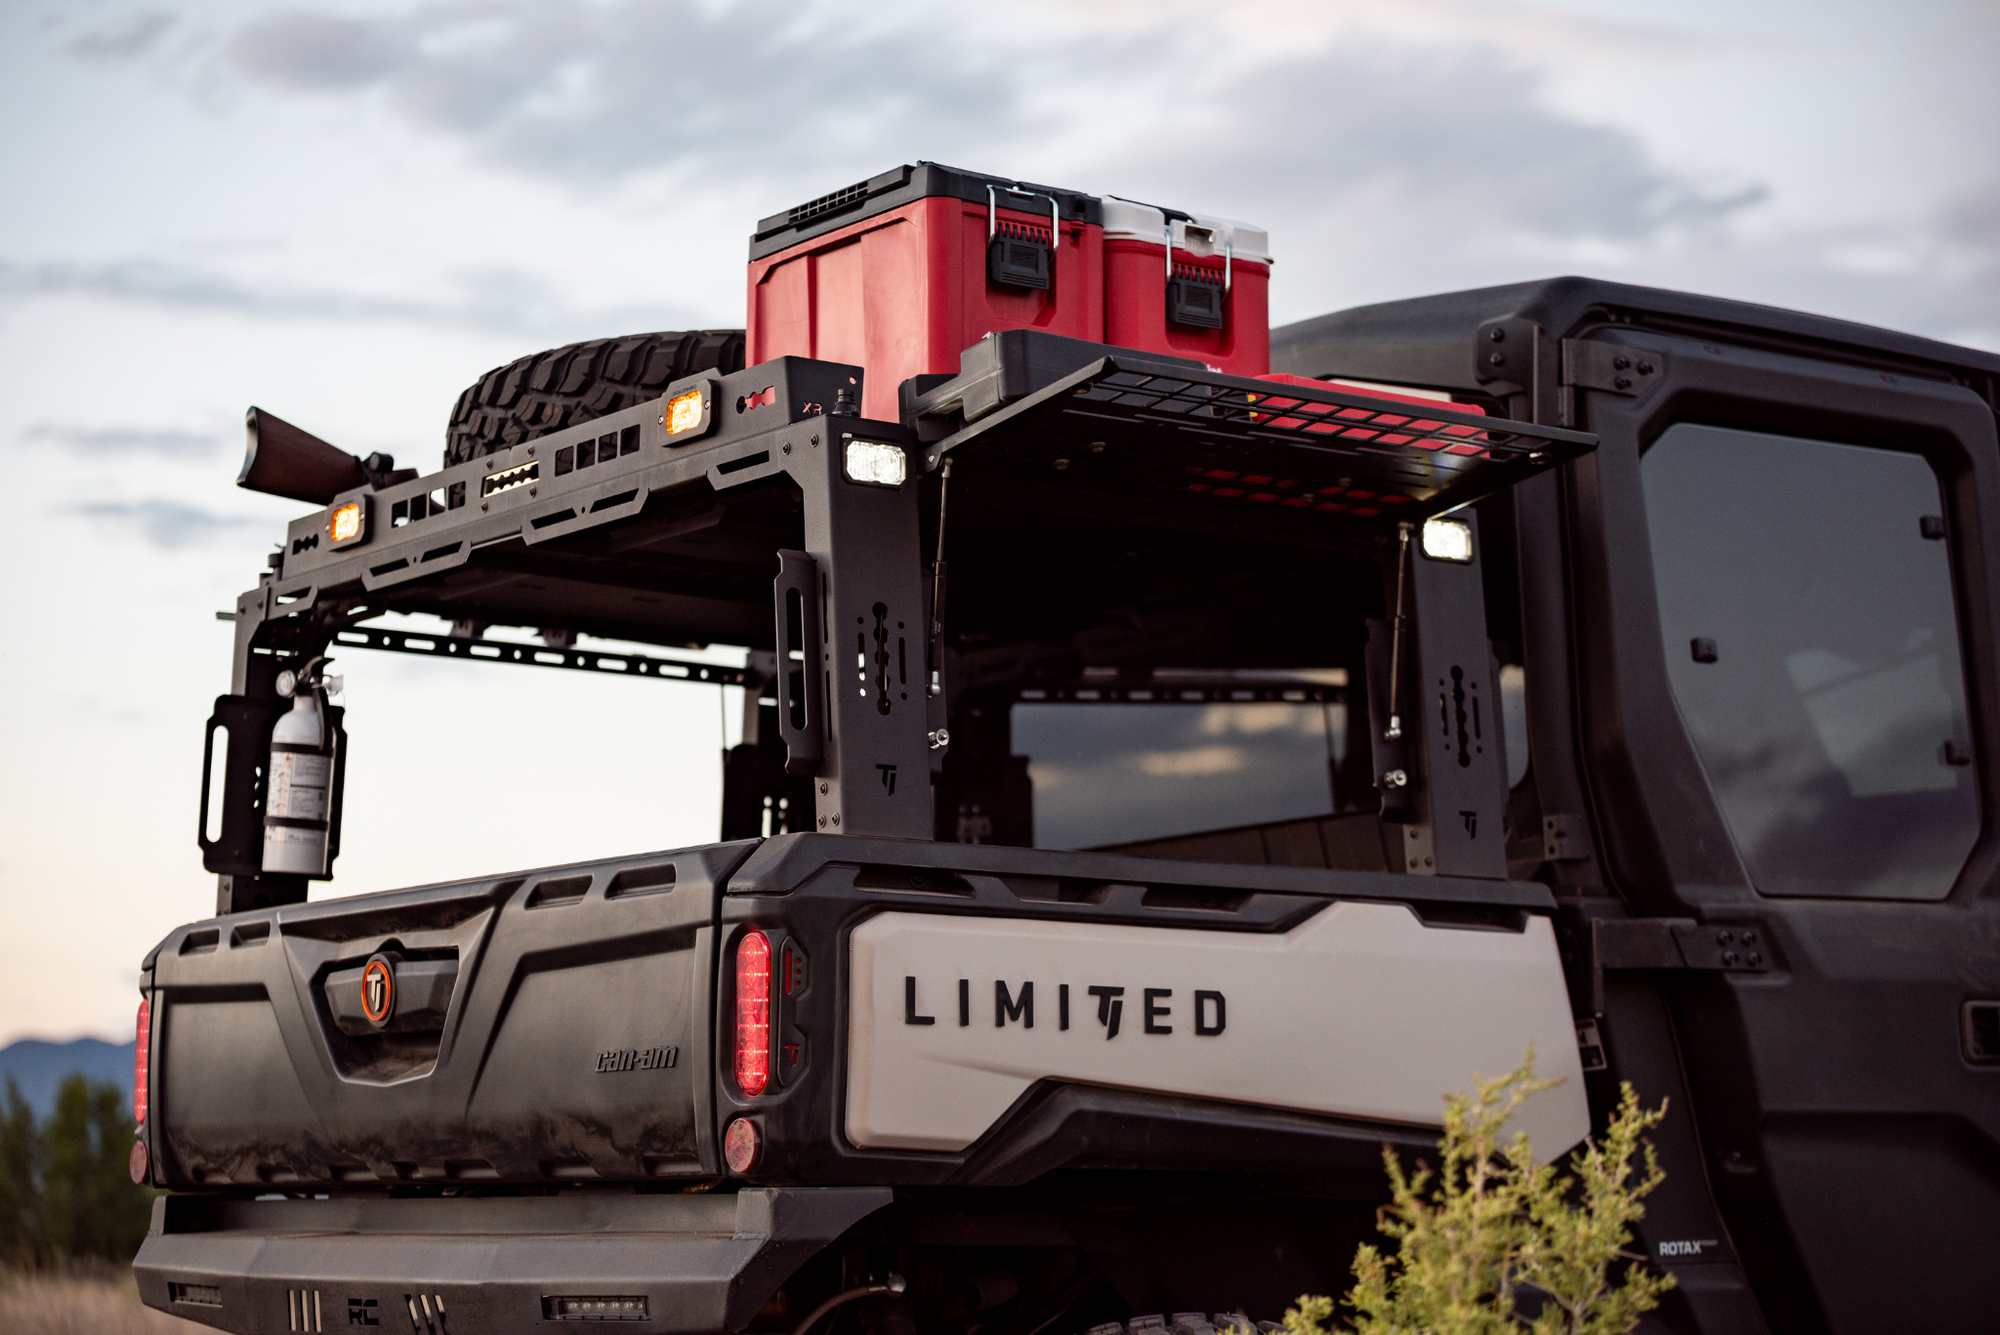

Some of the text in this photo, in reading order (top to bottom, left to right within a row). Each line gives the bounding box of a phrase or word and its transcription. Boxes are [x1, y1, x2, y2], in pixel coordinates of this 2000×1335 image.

[802, 401, 822, 415] XR
[905, 976, 1226, 1041] LIMITED
[1659, 1241, 1702, 1256] ROTAX
